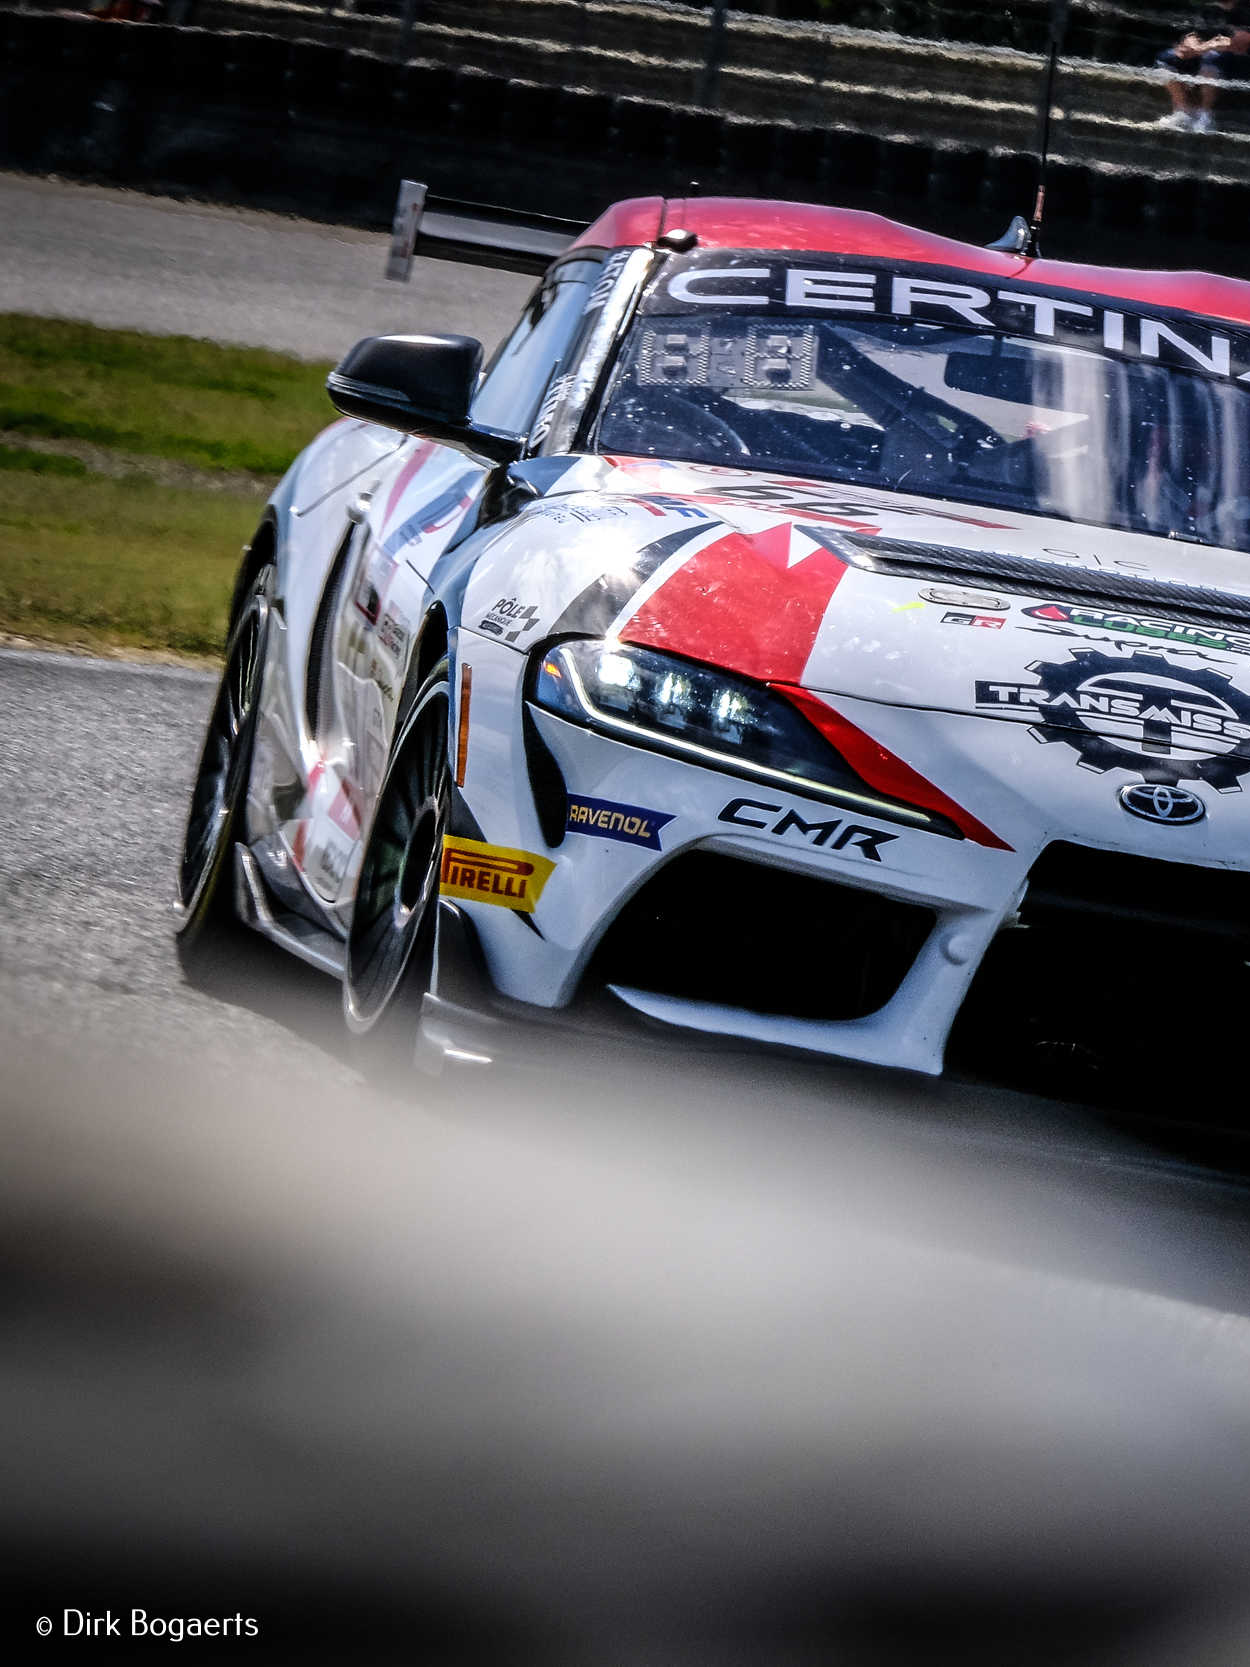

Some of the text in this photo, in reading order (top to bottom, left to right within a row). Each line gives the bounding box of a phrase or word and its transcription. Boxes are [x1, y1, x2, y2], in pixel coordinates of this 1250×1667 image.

[569, 805, 654, 838] RAVENOL
[717, 797, 900, 862] CMR
[440, 848, 534, 899] PIRELLI
